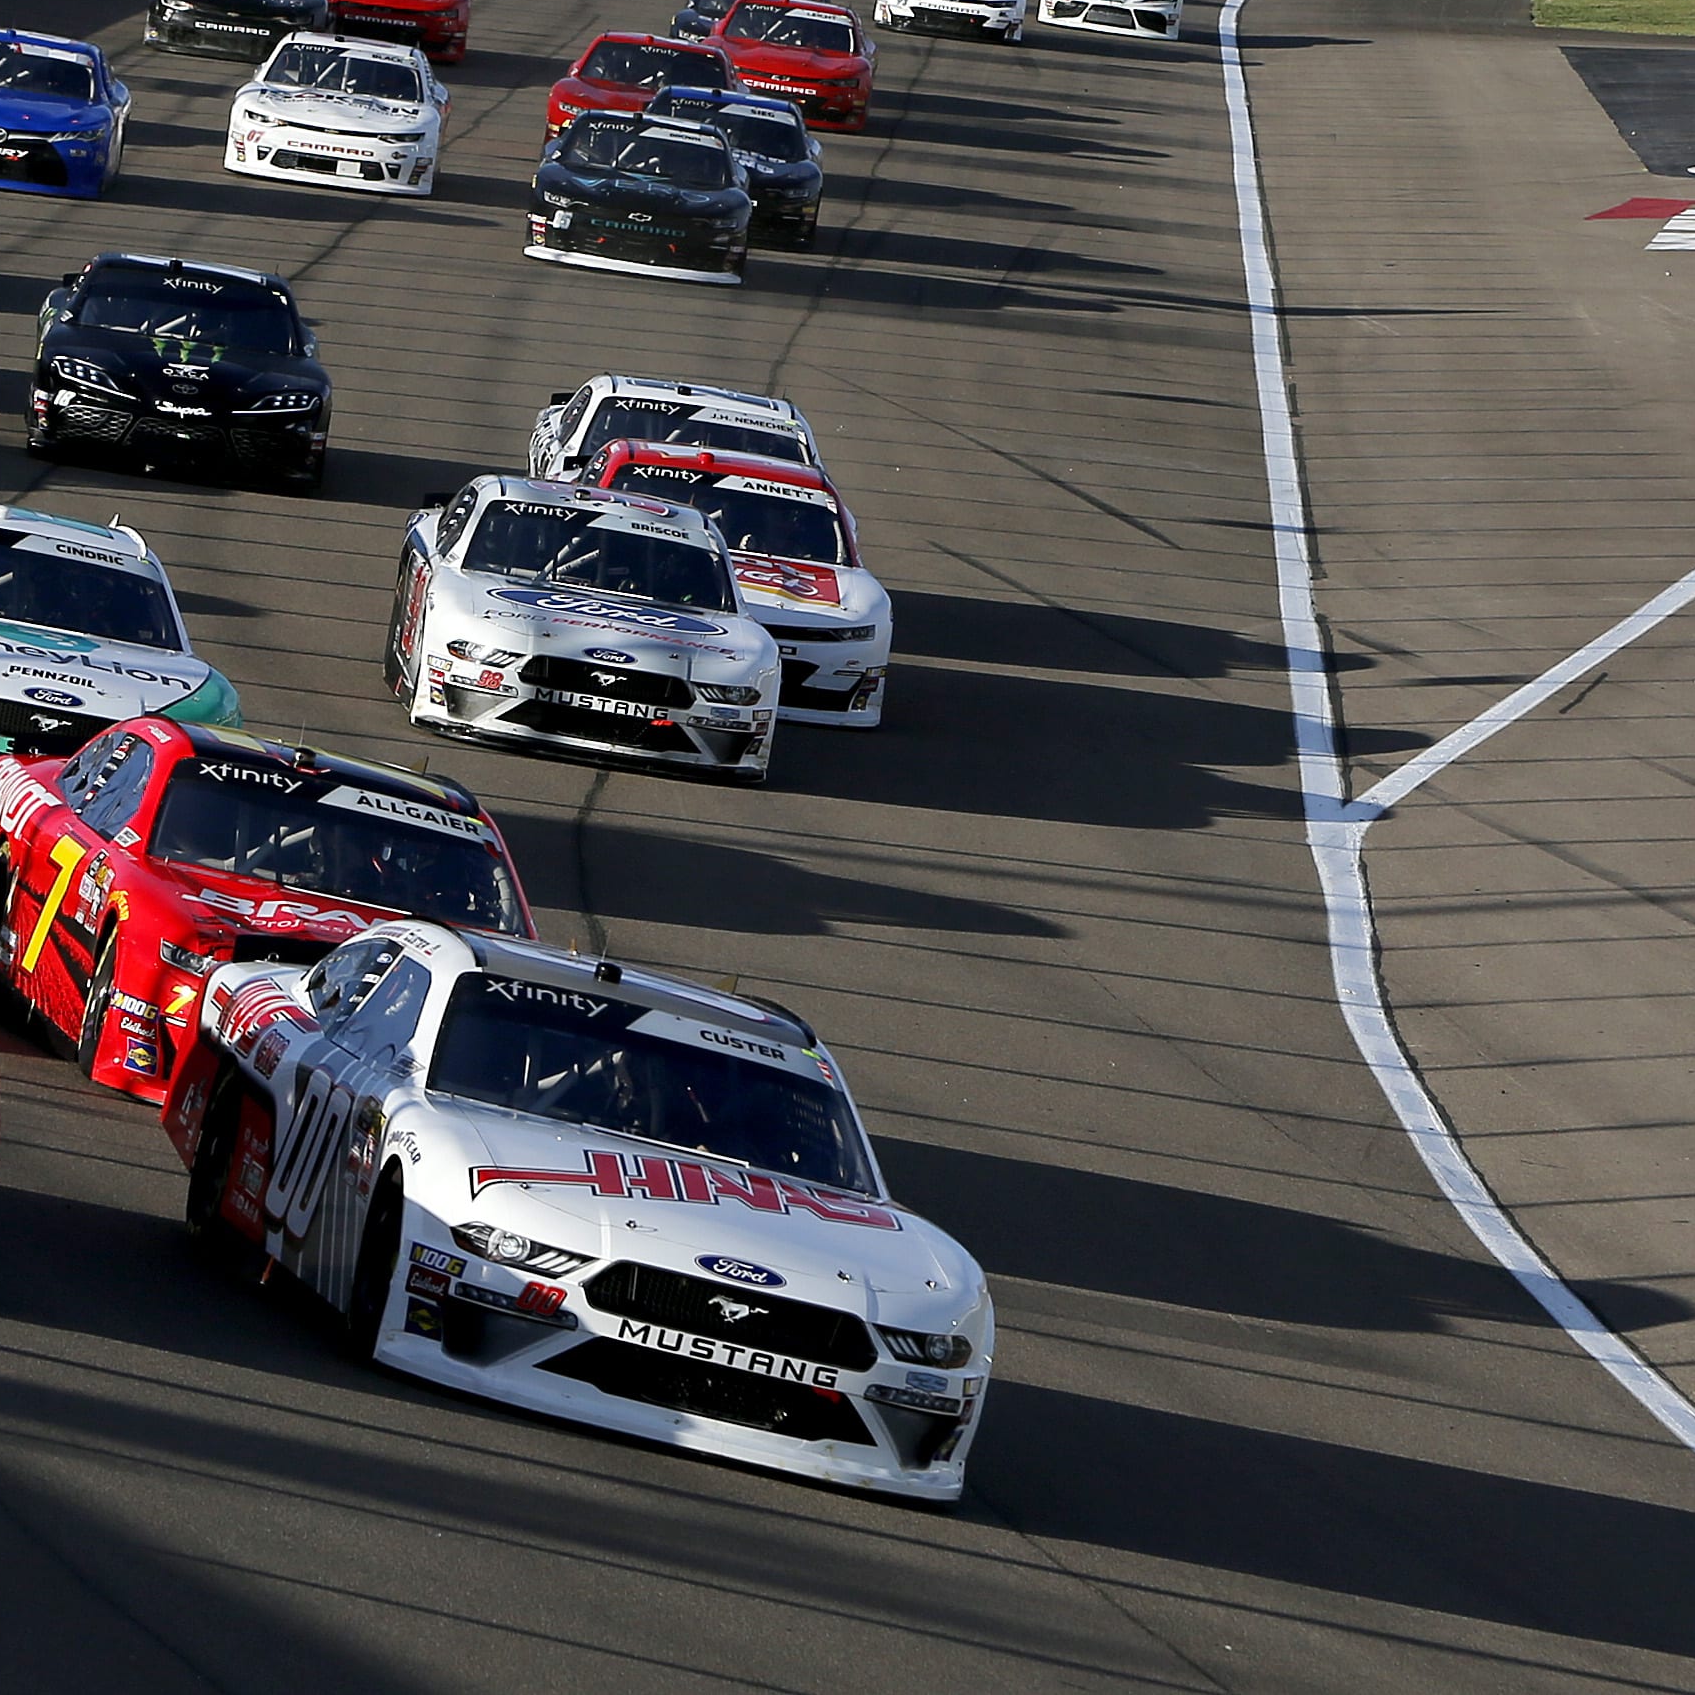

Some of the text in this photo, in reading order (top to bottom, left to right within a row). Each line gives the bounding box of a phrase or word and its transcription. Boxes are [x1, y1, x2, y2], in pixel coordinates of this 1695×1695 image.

[194, 21, 271, 37] CAMARO
[742, 78, 818, 96] CAMARO
[587, 121, 635, 134] xfinity
[286, 140, 375, 158] CAMARO
[163, 277, 224, 294] xfinity
[615, 399, 680, 415] xfinity
[735, 416, 795, 434] NEMECHEK
[633, 465, 703, 484] xfinity
[742, 481, 815, 501] ANNETT
[504, 502, 578, 522] xfinity
[631, 521, 691, 541] BRISCOE
[55, 542, 125, 567] CINDRIC
[536, 592, 677, 629] Ford
[551, 616, 738, 656] PERFORMANCE
[592, 649, 627, 664] Ford
[9, 664, 96, 690] PENNZOIL
[477, 669, 505, 690] 98
[34, 689, 73, 706] Ford
[534, 687, 670, 719] MUSTANG
[199, 762, 305, 795] xfinity
[356, 792, 483, 838] ALLGAIER
[164, 984, 198, 1015] 7
[486, 978, 608, 1017] xfinity
[699, 1028, 787, 1063] CUSTER
[469, 1148, 903, 1232] HAAS
[413, 1245, 465, 1276] MOOG
[712, 1257, 768, 1285] Ford
[515, 1280, 568, 1316] 00
[617, 1318, 840, 1390] MUSTANG
